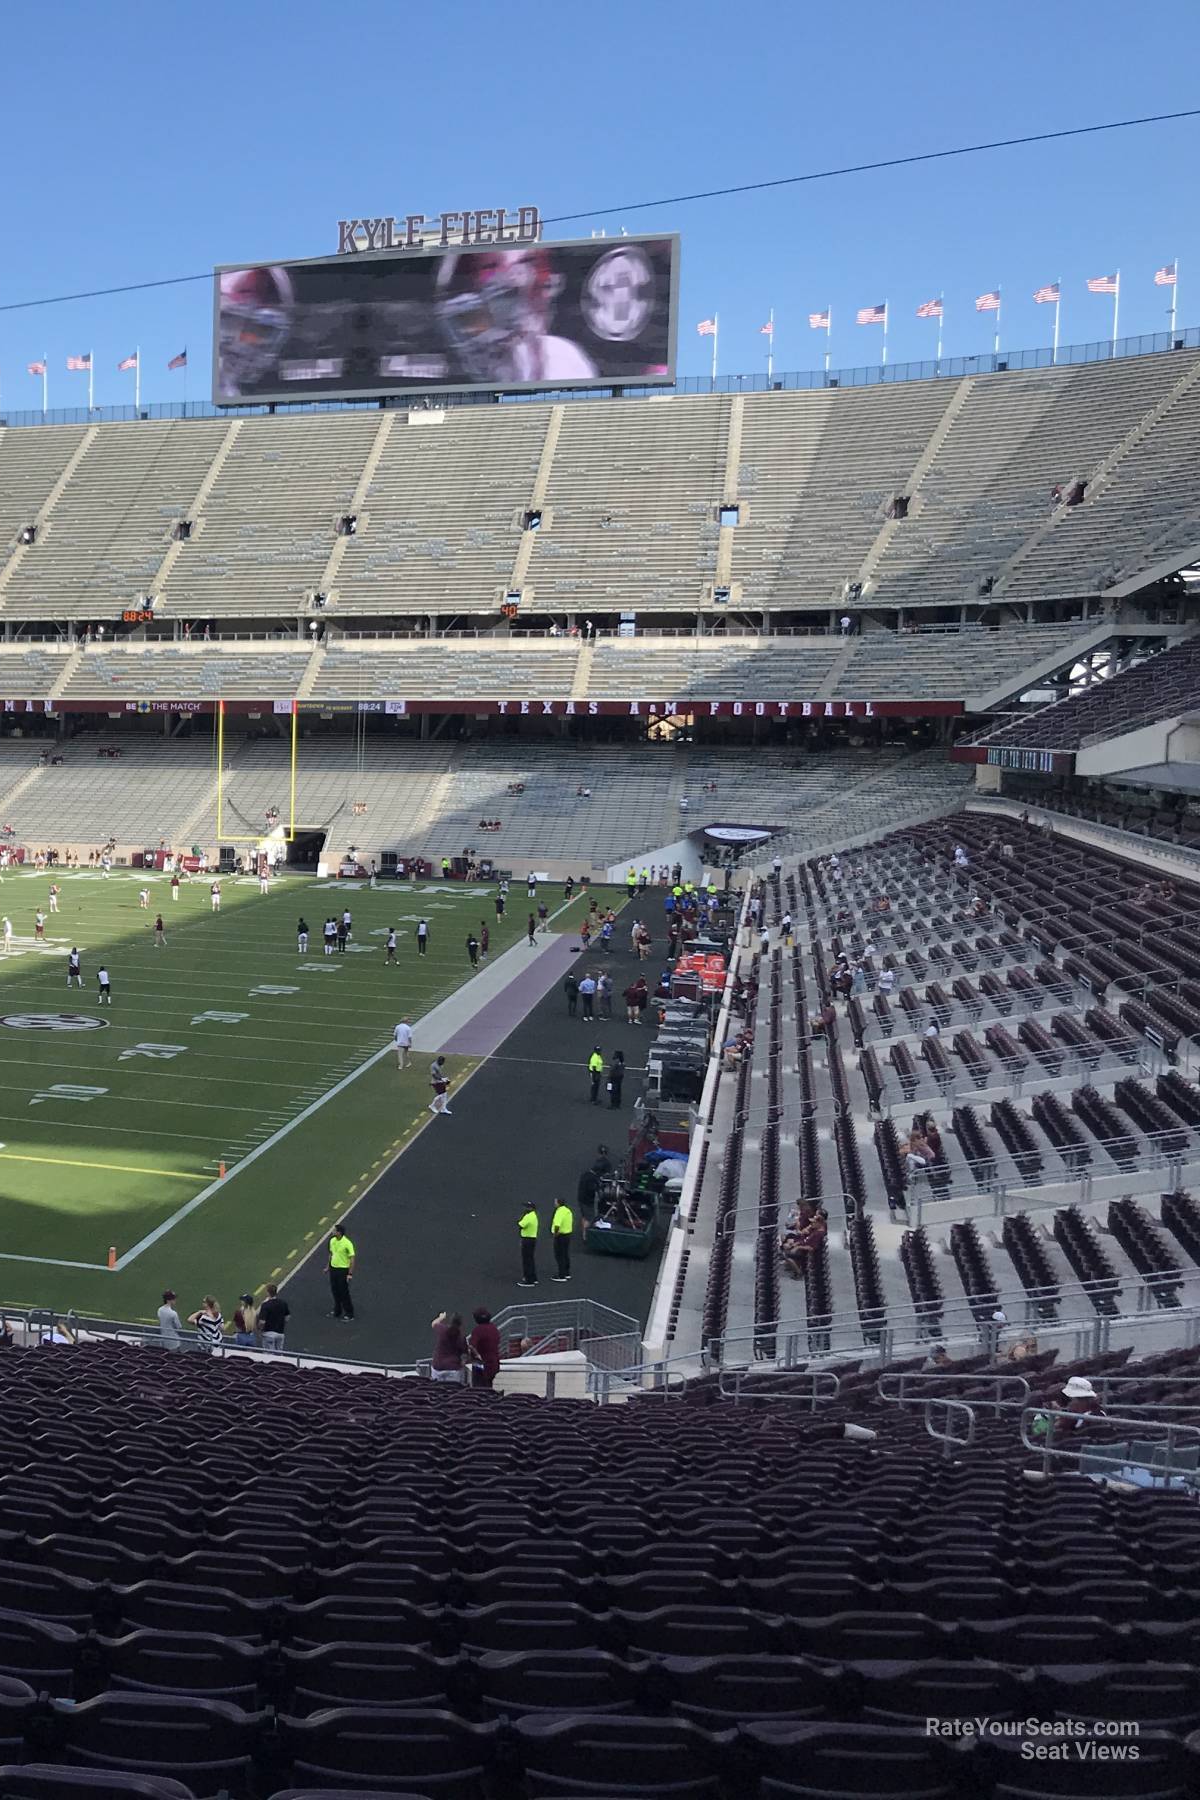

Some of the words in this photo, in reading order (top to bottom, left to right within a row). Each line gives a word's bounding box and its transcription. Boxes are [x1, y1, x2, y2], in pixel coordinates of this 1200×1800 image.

[337, 215, 425, 254] KYLE
[439, 206, 540, 247] FIELD
[4, 700, 53, 712] MAN
[125, 702, 136, 710] BE
[152, 702, 168, 710] THE
[170, 702, 201, 710] MATCH
[498, 702, 598, 714] TEXAS
[629, 703, 677, 715] A&M
[710, 703, 874, 715] FOOTBALL
[121, 1043, 189, 1059] 20
